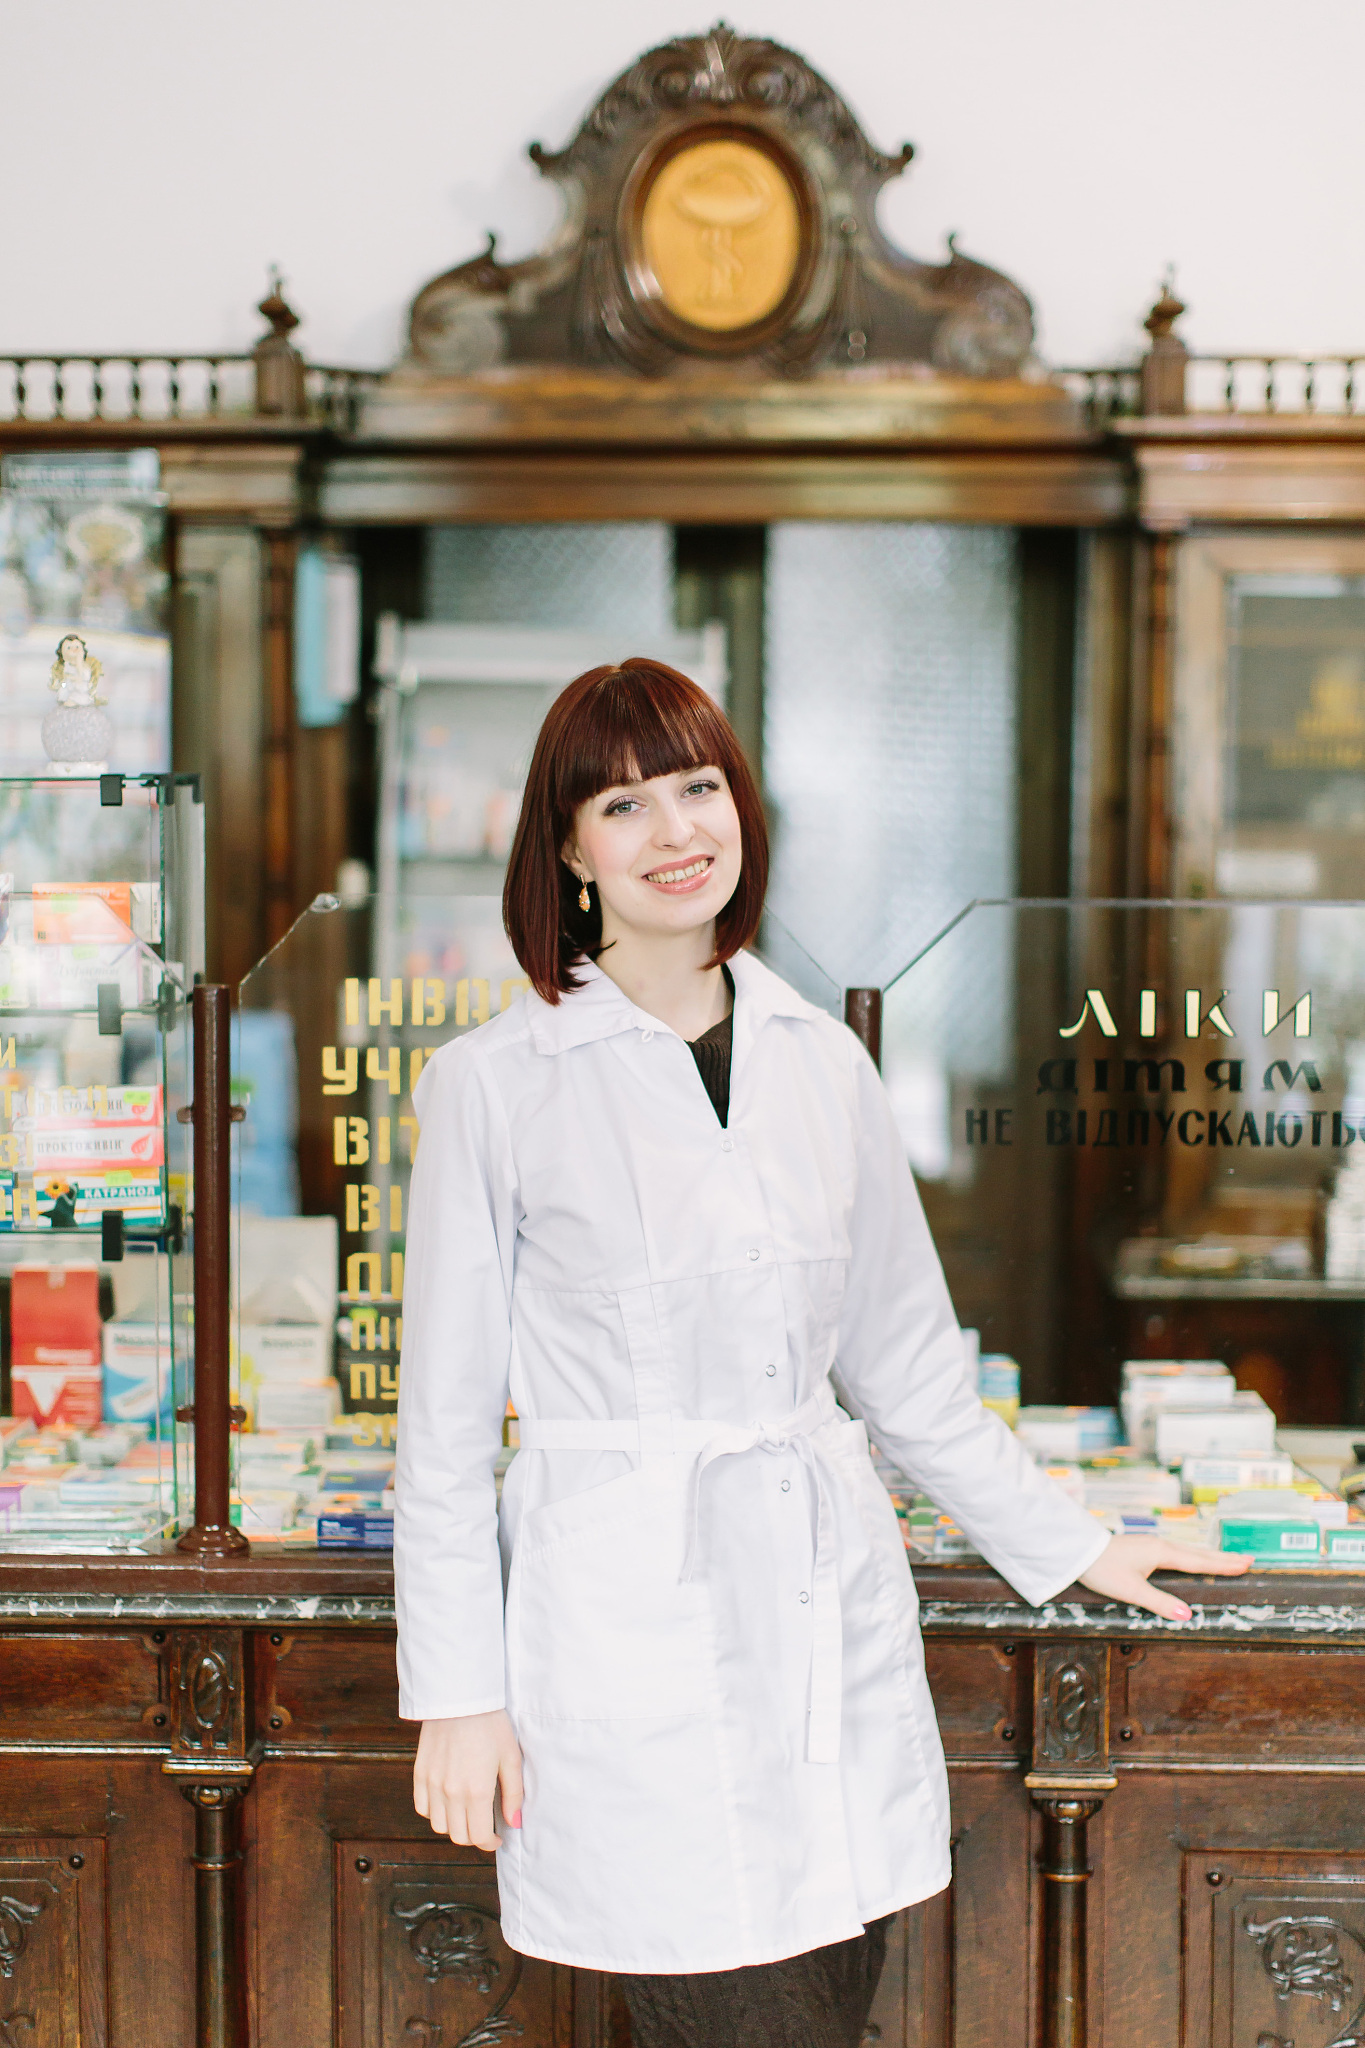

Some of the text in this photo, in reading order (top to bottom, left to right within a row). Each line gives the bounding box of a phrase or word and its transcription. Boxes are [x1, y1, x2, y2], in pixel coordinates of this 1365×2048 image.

[1059, 988, 1312, 1038] ЛІКИ
[965, 1109, 1012, 1145] НЕ
[84, 1186, 155, 1199] КАТРАНОЛ
[346, 1184, 402, 1232] ВІ
